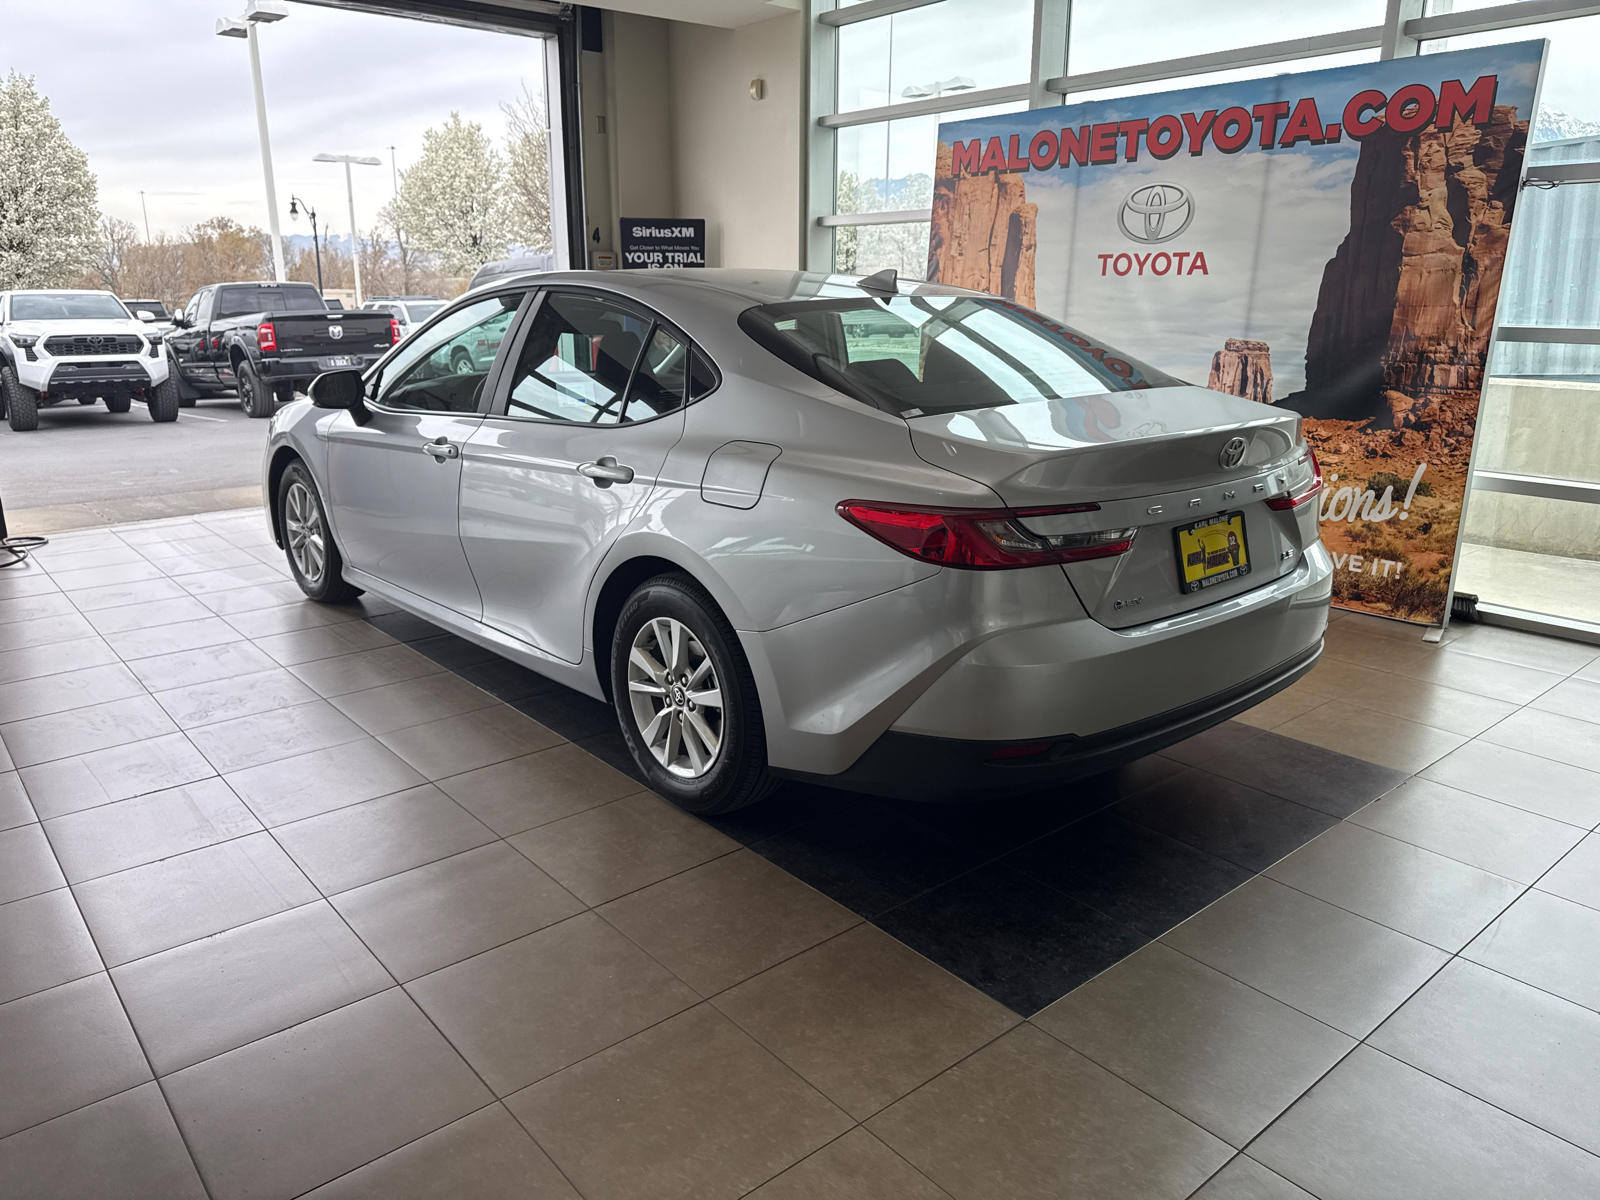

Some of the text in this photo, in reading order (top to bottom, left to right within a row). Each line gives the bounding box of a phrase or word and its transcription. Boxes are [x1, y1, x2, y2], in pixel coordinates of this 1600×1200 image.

[952, 75, 1499, 176] MALONETOYOTA.COM
[592, 227, 601, 244] 4
[632, 226, 695, 238] SiriusXM
[625, 252, 663, 263] YOUR
[665, 252, 704, 264] TRIAL
[1098, 251, 1209, 277] TOYOTA
[1147, 475, 1287, 515] CAMRY
[1319, 462, 1427, 523] ions!
[1194, 514, 1229, 529] KARL MALONE
[1228, 536, 1236, 547] 32
[1280, 549, 1294, 561] LE
[1332, 552, 1402, 580] VE IT!
[1201, 568, 1239, 588] MALONETOYOTA.COM
